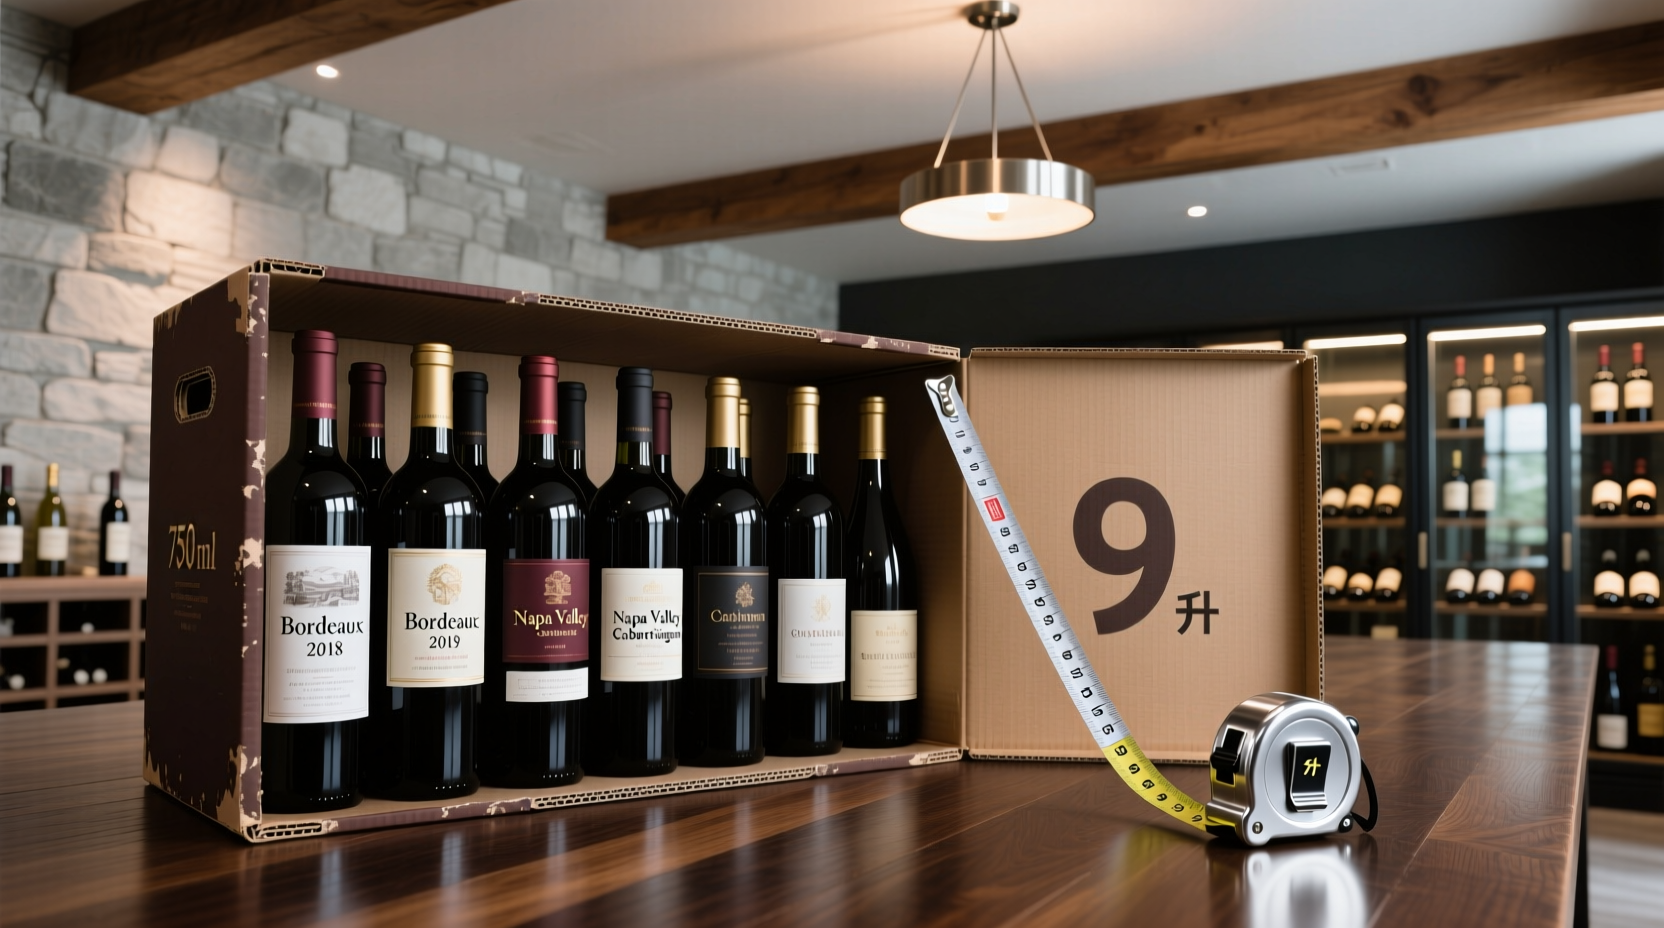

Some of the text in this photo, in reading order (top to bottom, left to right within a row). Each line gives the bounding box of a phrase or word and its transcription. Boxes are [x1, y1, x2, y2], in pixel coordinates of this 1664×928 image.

[280, 614, 364, 636] Bordeaux
[513, 609, 553, 631] Napa
[613, 609, 648, 629] Napa
[306, 640, 343, 657] 2018
[429, 634, 461, 650] 2019
